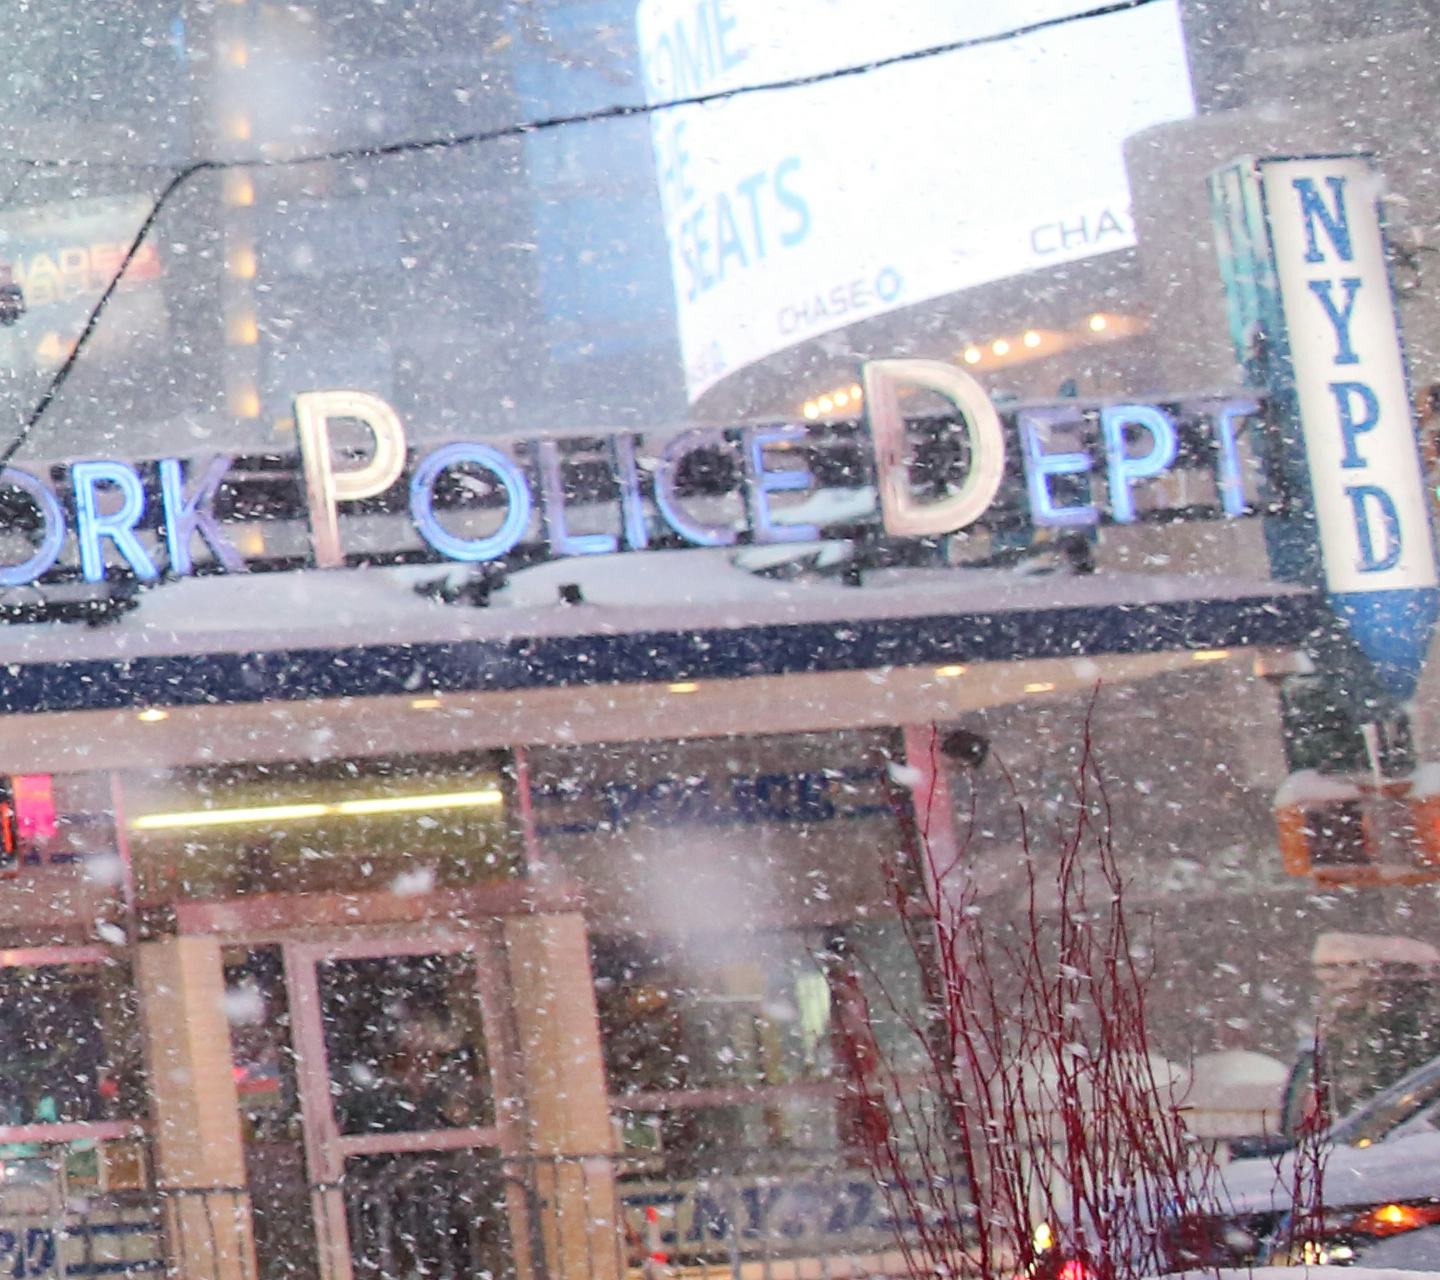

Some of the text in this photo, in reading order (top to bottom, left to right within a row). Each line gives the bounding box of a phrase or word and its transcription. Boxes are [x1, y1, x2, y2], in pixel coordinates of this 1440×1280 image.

[682, 154, 813, 304] SEATS
[777, 279, 873, 336] CHASE
[1291, 175, 1404, 574] NYPD
[293, 390, 821, 569] POLICE
